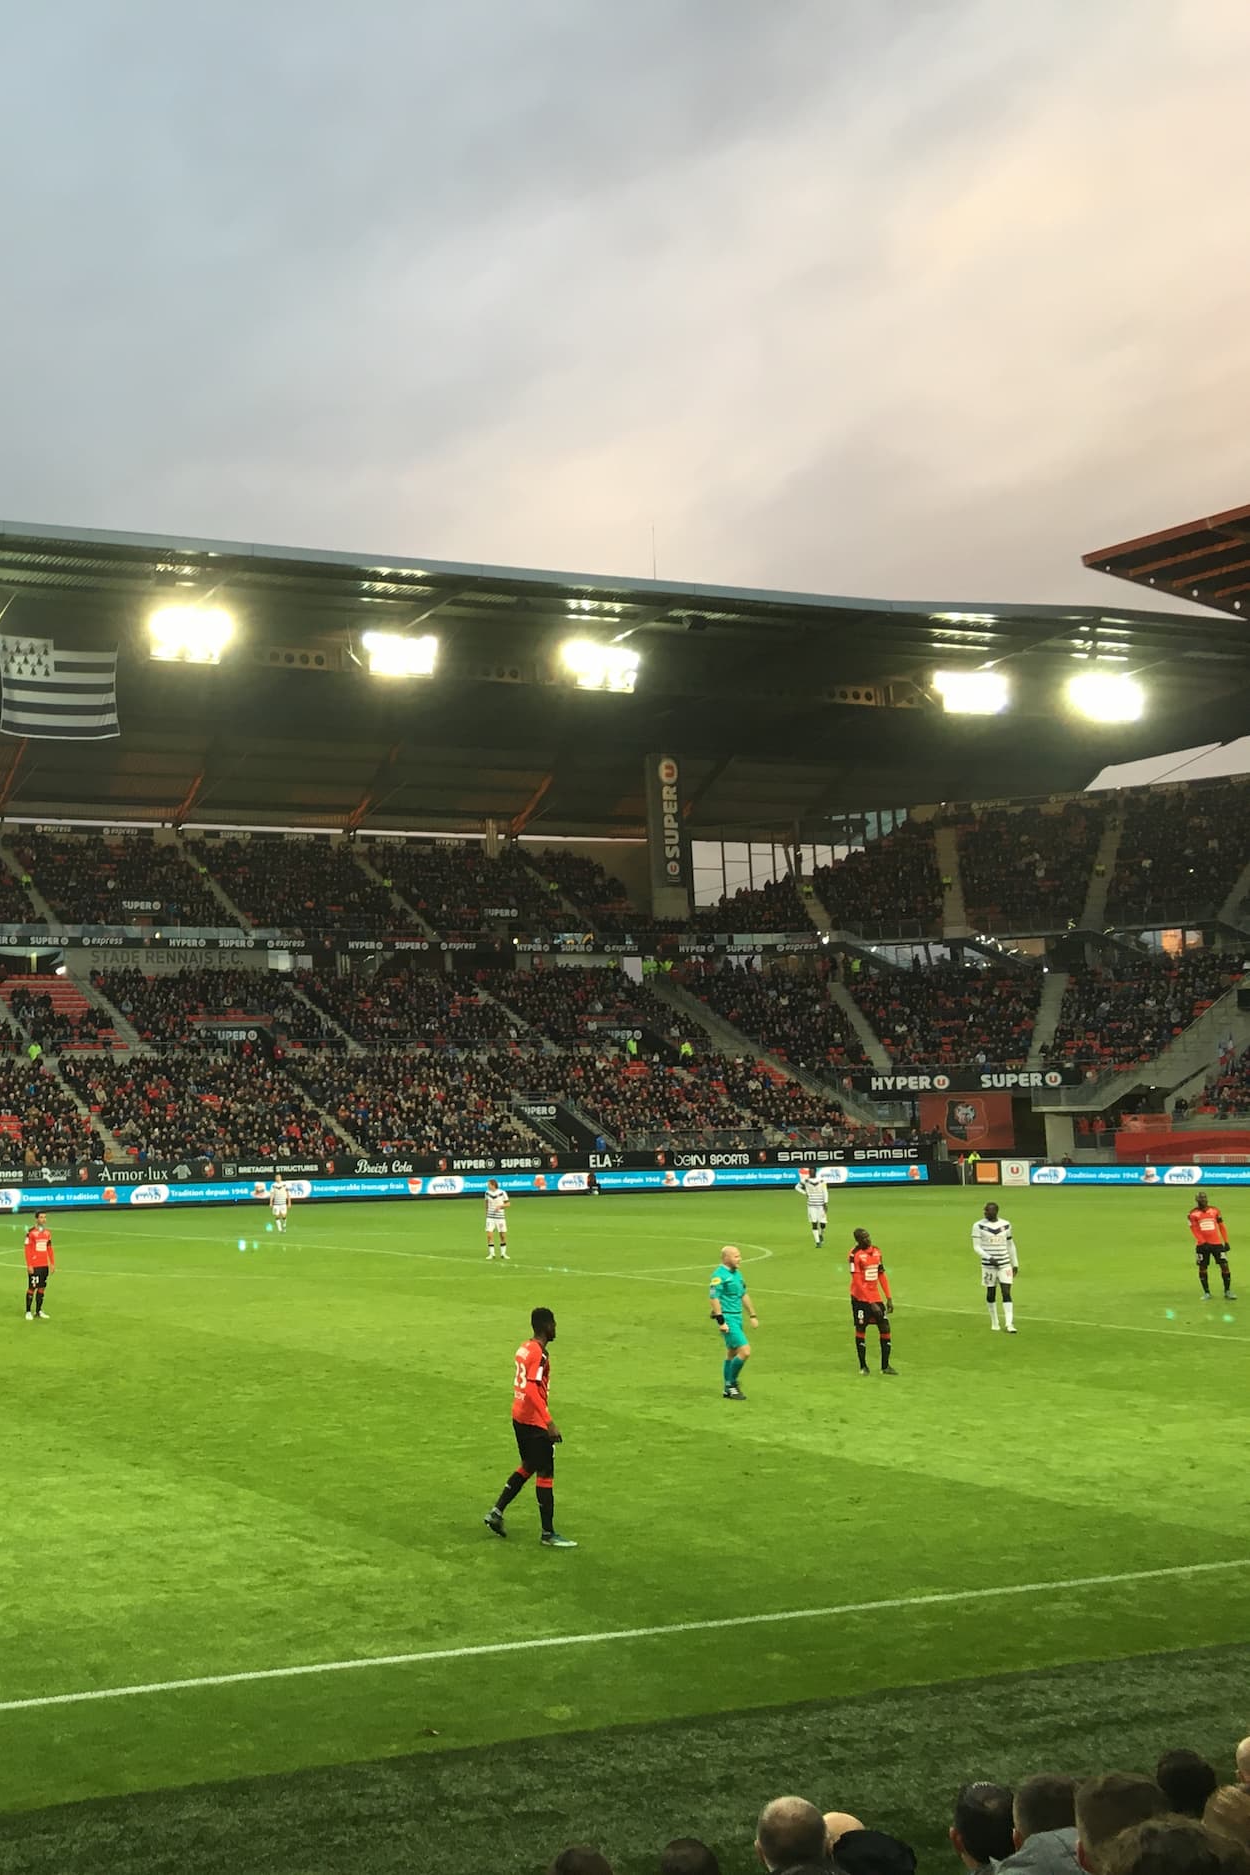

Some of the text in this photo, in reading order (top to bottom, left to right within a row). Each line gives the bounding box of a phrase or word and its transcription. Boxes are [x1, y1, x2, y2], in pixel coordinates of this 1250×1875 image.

[661, 785, 680, 858] SUPER
[122, 900, 153, 910] SUPER
[30, 937, 59, 945] SUPER
[91, 937, 123, 946] express
[169, 939, 199, 947] HYPER
[218, 939, 246, 948] SUPER
[275, 940, 306, 949] express
[348, 941, 376, 949] HYPER
[395, 942, 421, 950] SUPER
[448, 942, 476, 951] express
[516, 944, 543, 952] HYPER
[560, 944, 586, 953] SUPER
[678, 945, 706, 953] HYPER
[726, 945, 754, 953] SUPER
[785, 943, 819, 952] express
[91, 950, 142, 964] STADE
[145, 950, 213, 964] RENNAIS
[214, 1031, 246, 1041] UPER
[871, 1076, 932, 1091] HYPER
[980, 1072, 1043, 1088] SUPER
[777, 1150, 845, 1161] SAMSIC
[853, 1148, 919, 1160] SAMSIC
[453, 1159, 486, 1170] HYPER
[501, 1158, 532, 1169] SUPER
[589, 1155, 612, 1168] ELA
[710, 1153, 750, 1166] SPORTS
[238, 1164, 319, 1174] BRETAGNE STRUCTURES
[355, 1158, 413, 1175] Breizh Cola
[1067, 1171, 1097, 1180] Tradition
[1097, 1172, 1121, 1180] depuis
[313, 1184, 361, 1193] Incomparable
[389, 1181, 404, 1190] frais
[22, 1191, 100, 1202] Desserts de tradition
[171, 1189, 204, 1198] Tradition
[205, 1188, 230, 1197] depuis
